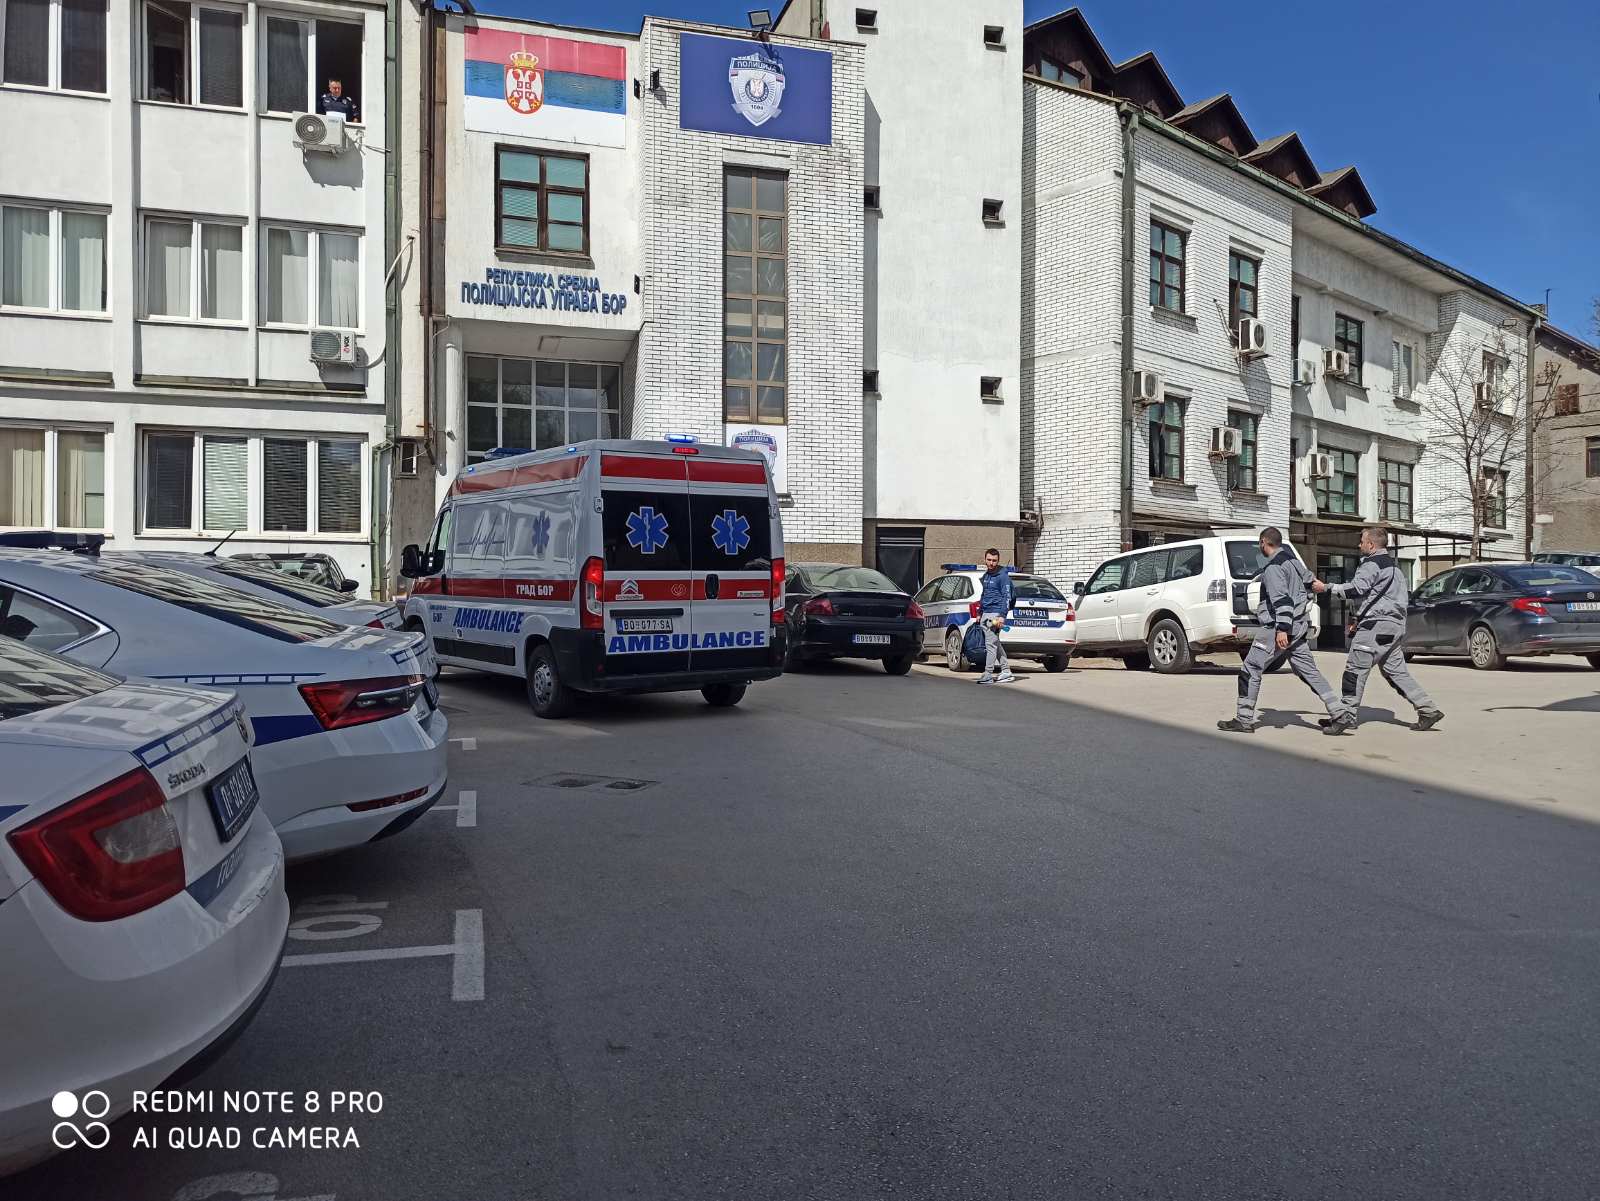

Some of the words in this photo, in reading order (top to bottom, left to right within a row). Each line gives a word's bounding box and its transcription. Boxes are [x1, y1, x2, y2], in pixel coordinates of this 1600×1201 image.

[486, 267, 555, 289] РЕПУБЛИКА
[558, 274, 600, 292] СРБИЈА
[461, 282, 548, 309] ПОЛИЦИЈСКА
[550, 289, 599, 313] УПРАВА
[601, 294, 627, 315] БОР
[516, 584, 536, 596] ГРАД
[537, 585, 554, 595] БОР
[453, 607, 525, 633] AMBULANCE
[608, 630, 765, 653] AMBULANCE
